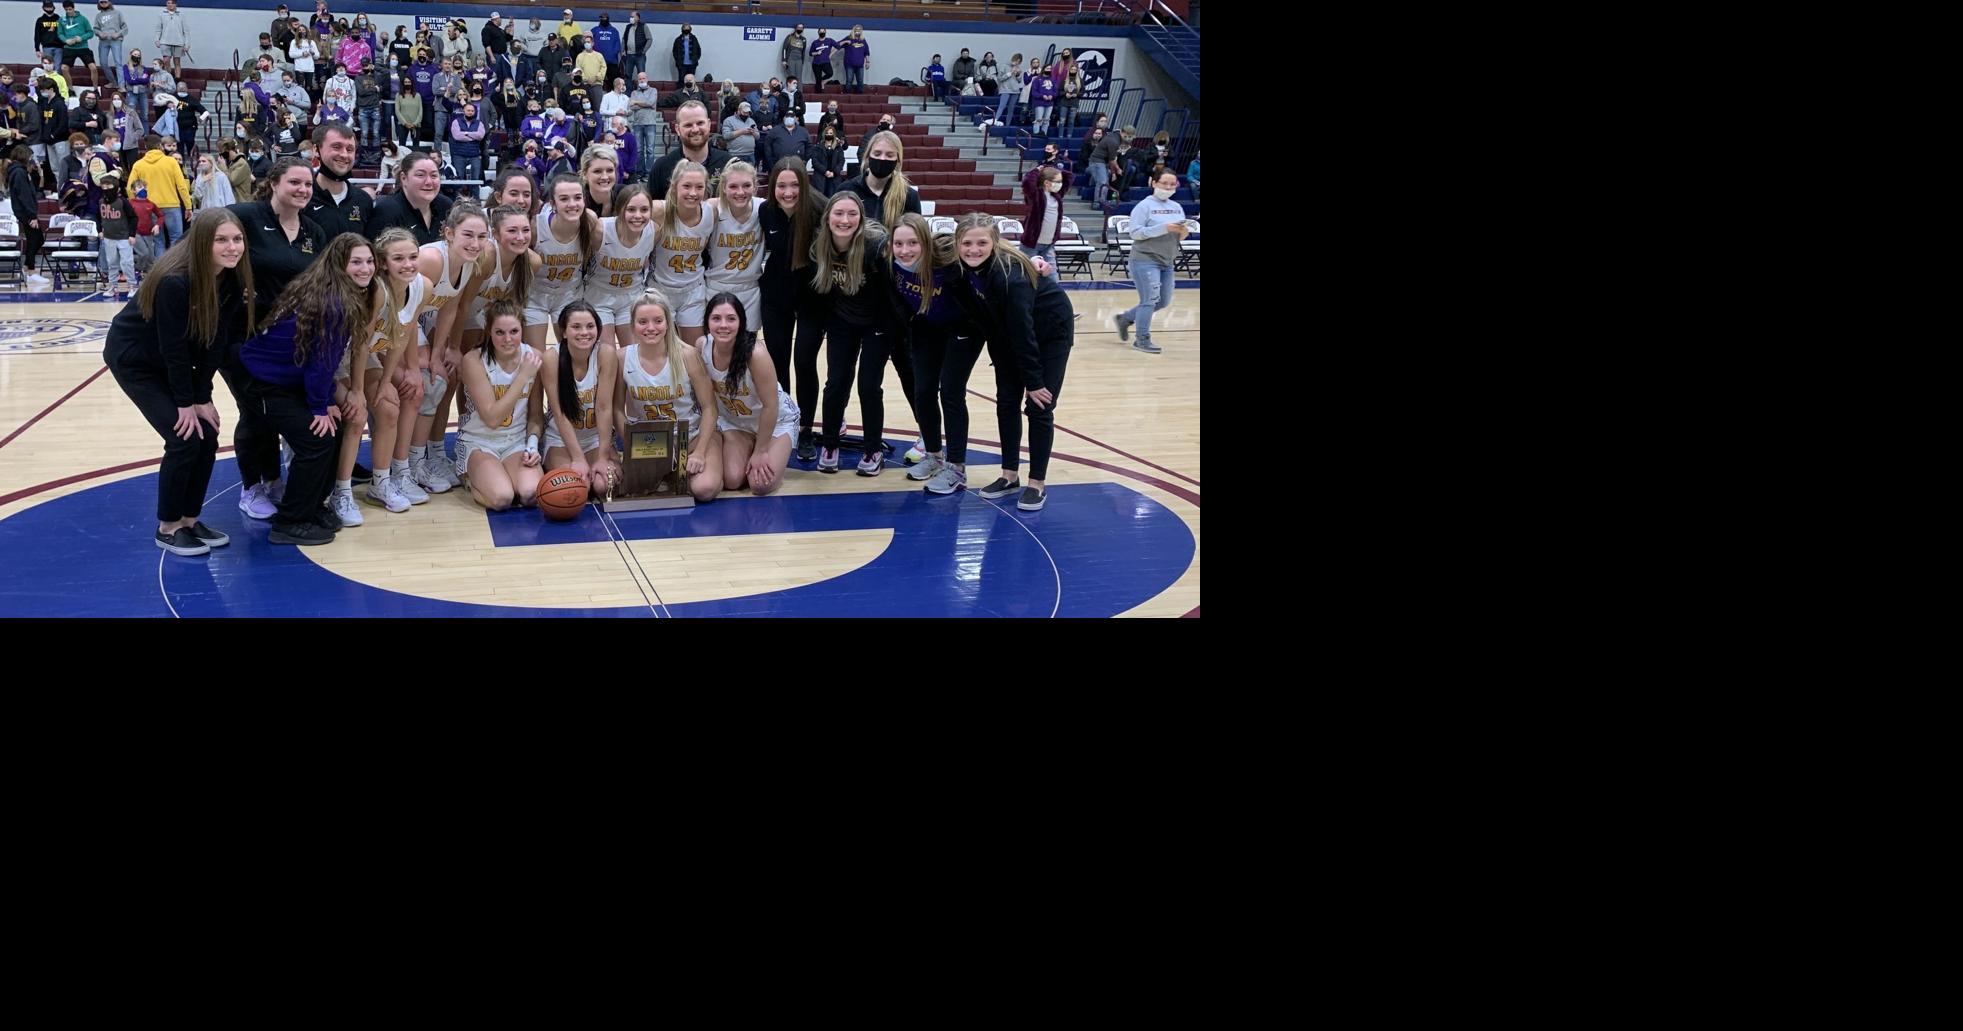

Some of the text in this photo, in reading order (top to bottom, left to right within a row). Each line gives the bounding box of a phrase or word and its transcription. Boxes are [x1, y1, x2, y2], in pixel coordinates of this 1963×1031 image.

[100, 203, 121, 219] Ohio
[668, 254, 699, 273] 44
[725, 248, 753, 271] 33
[609, 273, 633, 288] 15
[630, 384, 685, 401] ANGOLA
[550, 475, 583, 487] Wilson
